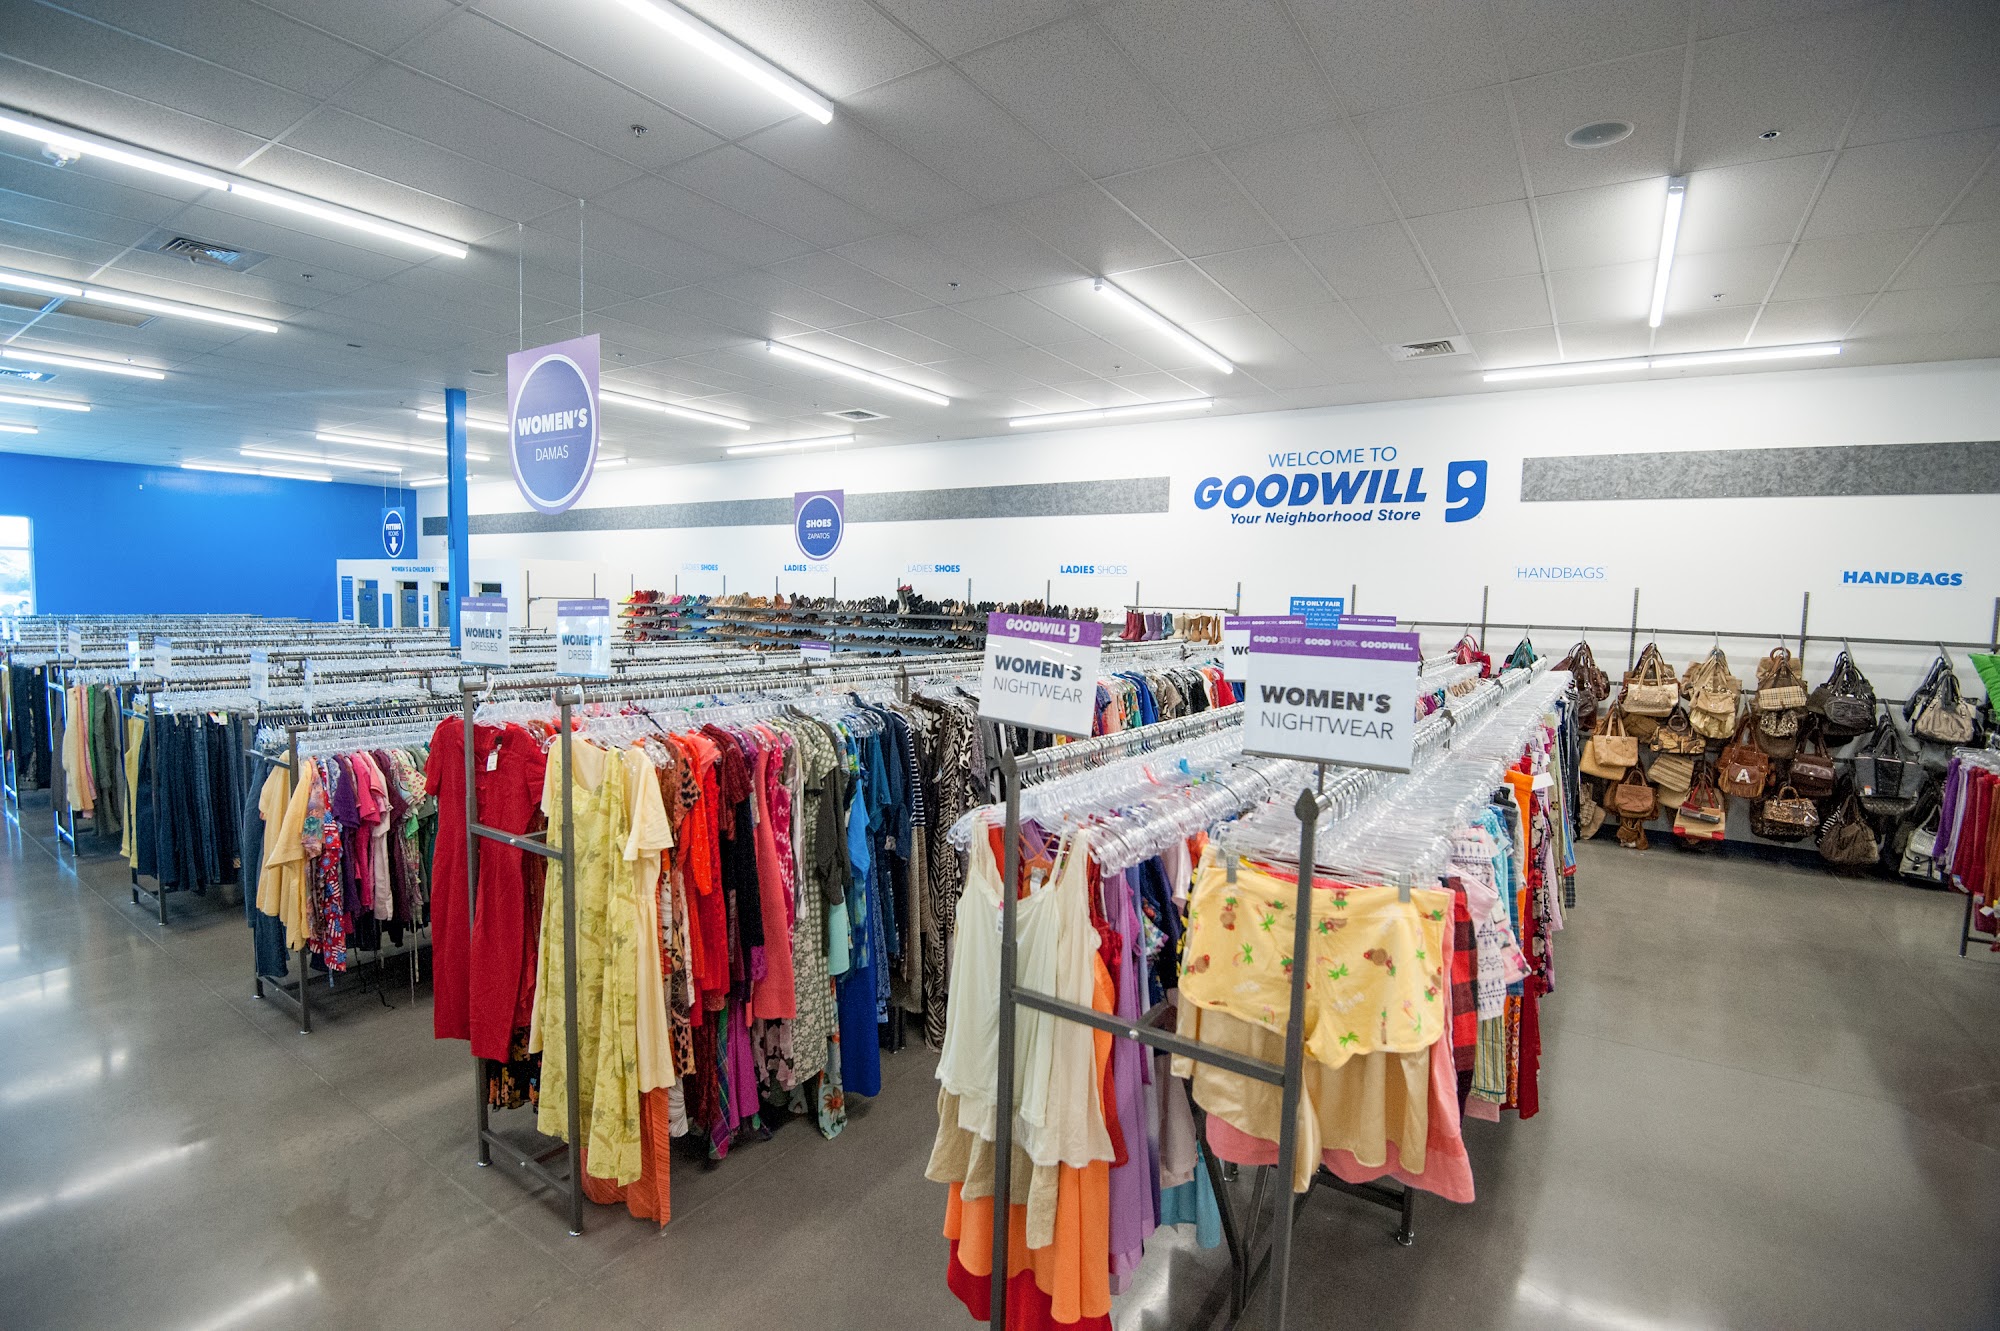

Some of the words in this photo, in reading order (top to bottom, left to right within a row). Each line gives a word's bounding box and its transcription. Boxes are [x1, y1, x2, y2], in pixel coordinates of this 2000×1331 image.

[518, 408, 588, 436] WOMEN'S
[536, 444, 568, 461] DAMAS
[1269, 448, 1364, 467] WELCOME
[1370, 446, 1397, 463] TO
[1194, 467, 1427, 510] GOODWILL
[806, 518, 832, 529] SHOES
[1231, 513, 1261, 525] Your
[1265, 510, 1375, 526] Neighborhood
[1377, 509, 1420, 522] Store
[808, 532, 830, 540] ZAPATOS
[785, 564, 807, 572] LADIES
[908, 565, 932, 573] LADIES
[935, 565, 960, 573] SHOES
[1060, 565, 1094, 573] LADIES
[1098, 565, 1128, 574] SHOES
[1517, 567, 1604, 579] HANDBAGS
[1843, 571, 1963, 586] HANDBAGS
[465, 628, 502, 639] WOMEN'S
[1006, 618, 1066, 636] GOODWILL
[471, 641, 499, 652] DRESSES
[562, 635, 602, 646] WOMEN'S
[1253, 635, 1278, 643] GOOD
[1304, 638, 1331, 646] GOOD
[1360, 641, 1413, 651] GOODWILL.
[568, 650, 593, 660] DRESSE
[995, 655, 1082, 682] WOMEN'S
[993, 676, 1083, 704] NIGHTWEAR
[1260, 685, 1392, 714] WOMEN'S
[1261, 711, 1394, 740] NIGHTWEAR
[1735, 768, 1751, 784] A
